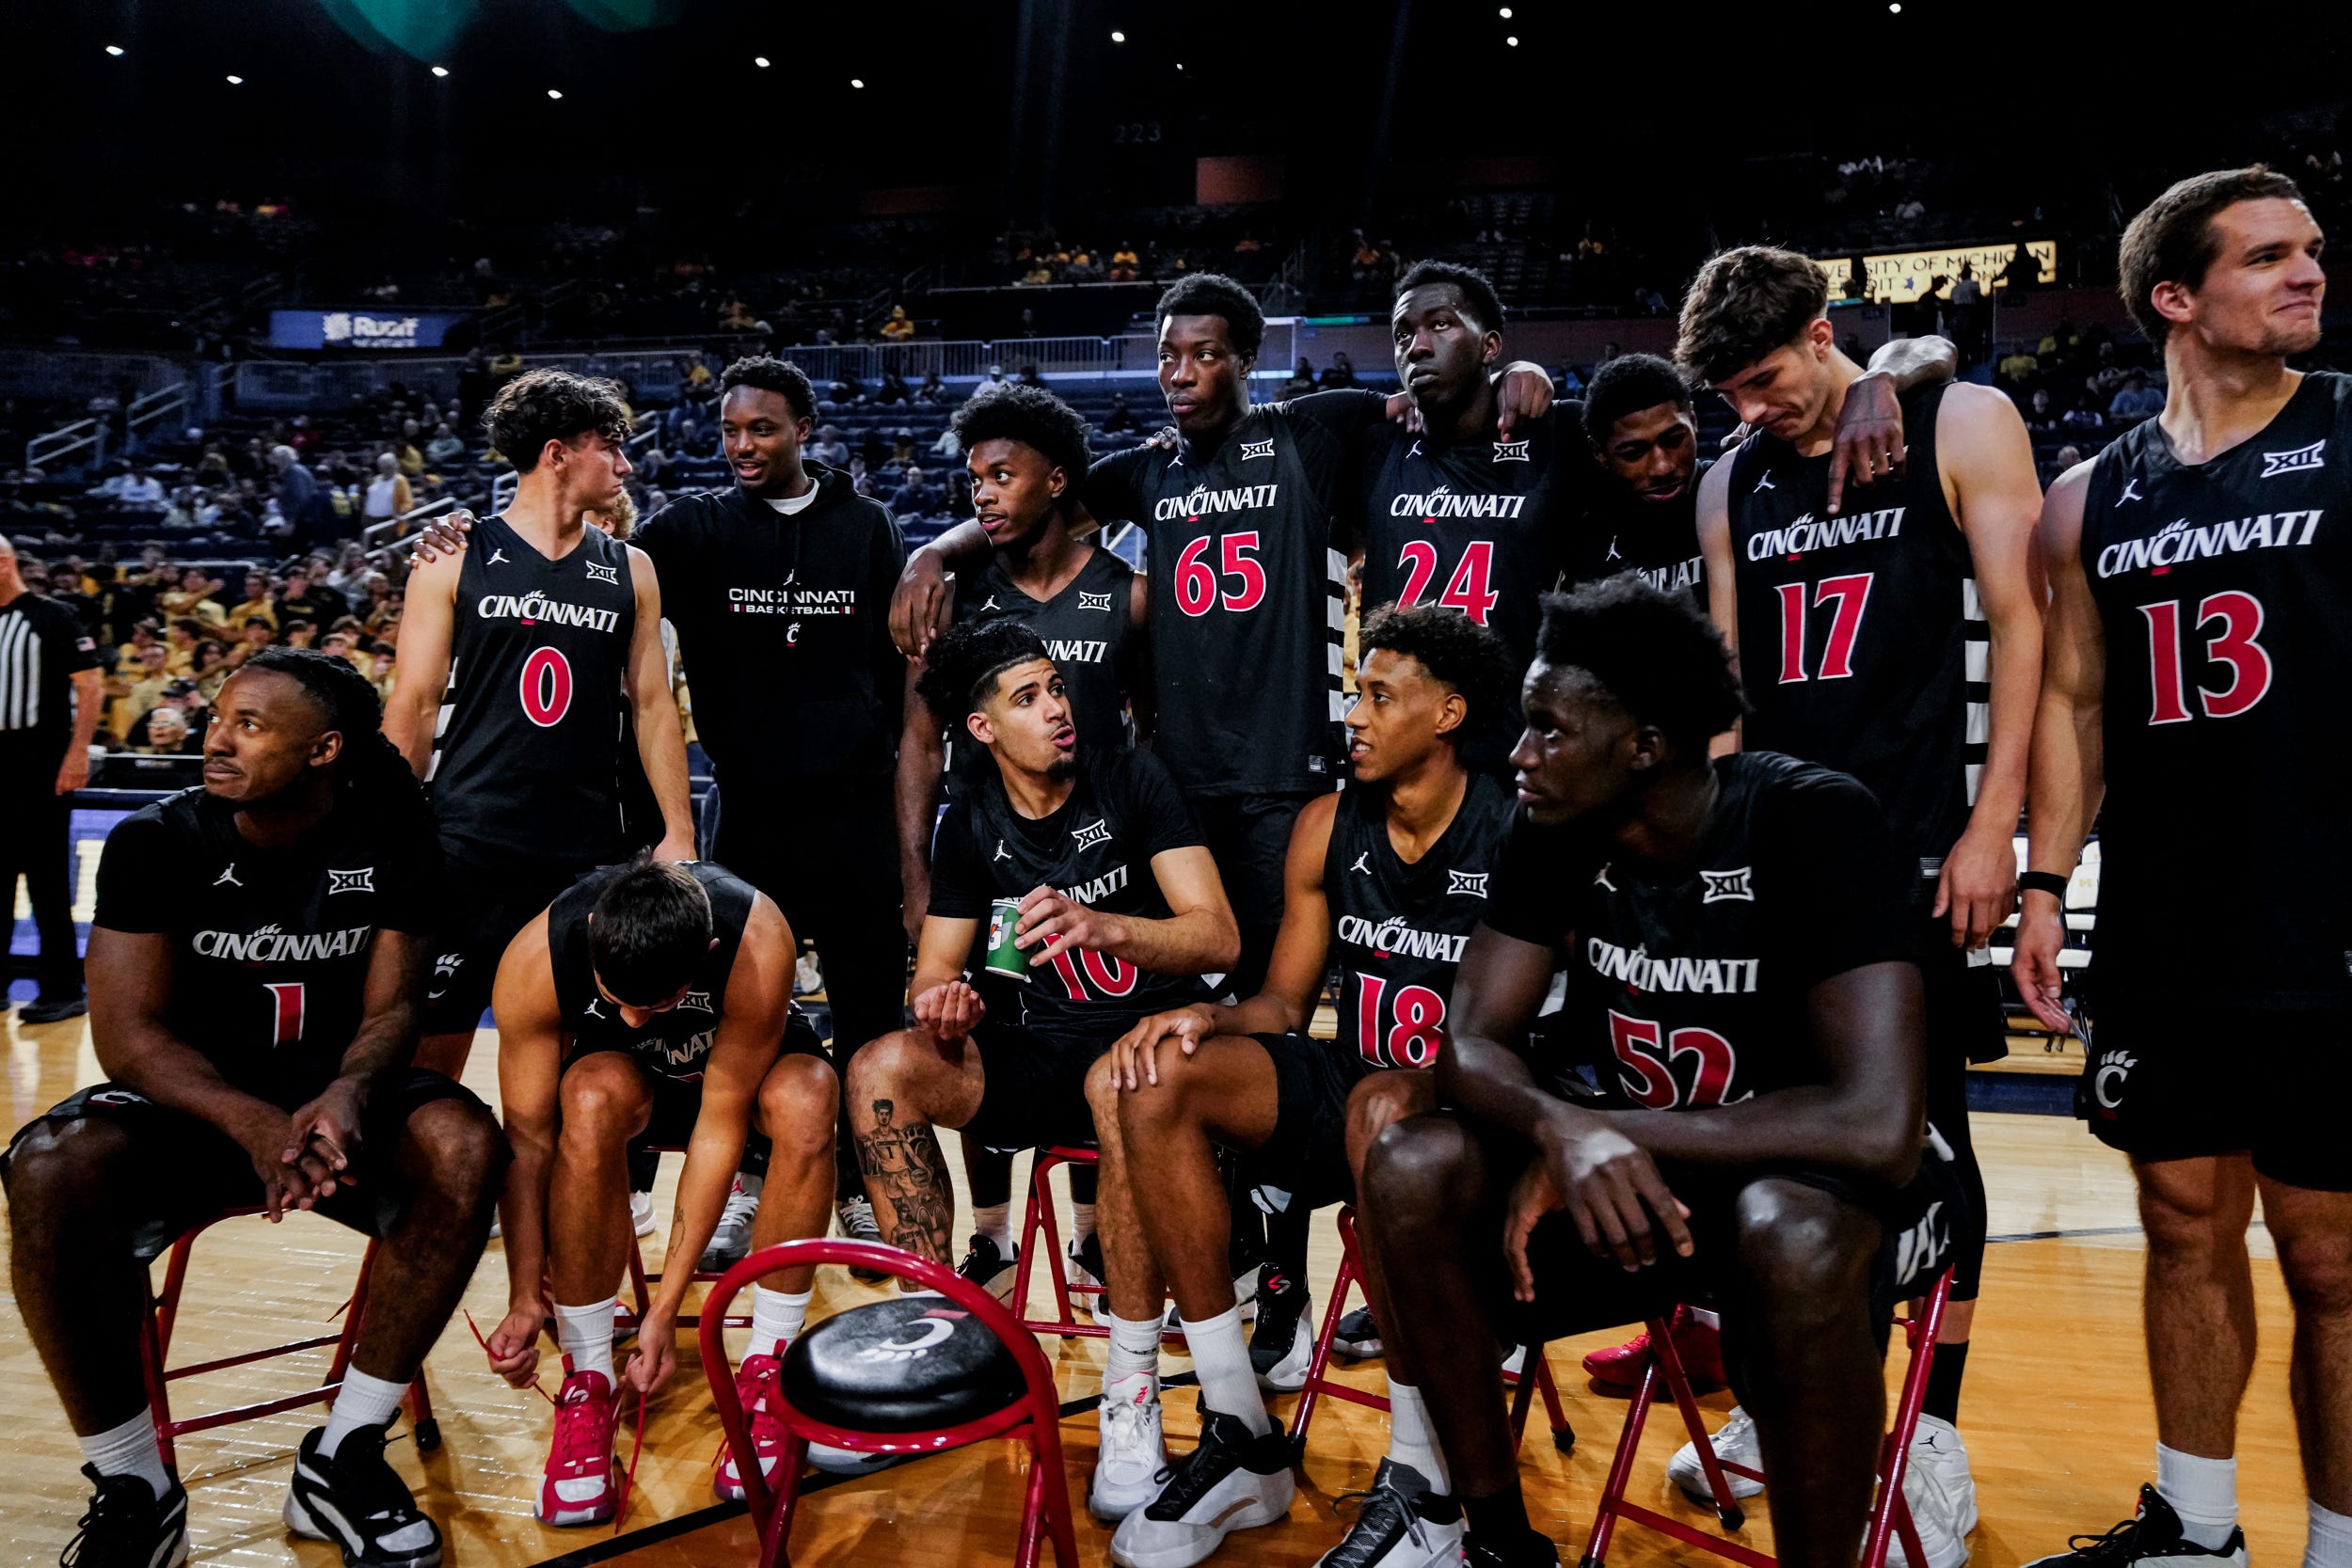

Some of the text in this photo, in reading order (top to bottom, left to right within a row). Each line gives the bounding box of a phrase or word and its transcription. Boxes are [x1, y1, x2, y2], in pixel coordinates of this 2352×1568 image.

[1914, 256, 1940, 272] OF
[1154, 483, 1279, 522] CINCINNATI
[1390, 484, 1526, 518] CINCINNATI
[1747, 506, 1907, 562] CINCINNATI
[1175, 531, 1266, 617] 65
[2097, 510, 2325, 578] CINCINNATI
[478, 590, 620, 633] CINCINNATI
[1396, 540, 1500, 627] 24
[1773, 572, 1874, 685] 17
[2136, 590, 2273, 726] 13
[519, 646, 573, 727] 0
[192, 923, 372, 961] CINCINNAT
[1338, 915, 1470, 962] CINCINNAT
[1588, 937, 1760, 993] CINCINNATI
[262, 982, 305, 1049] 1
[1356, 971, 1446, 1069] 18
[1608, 1008, 1755, 1110] 52
